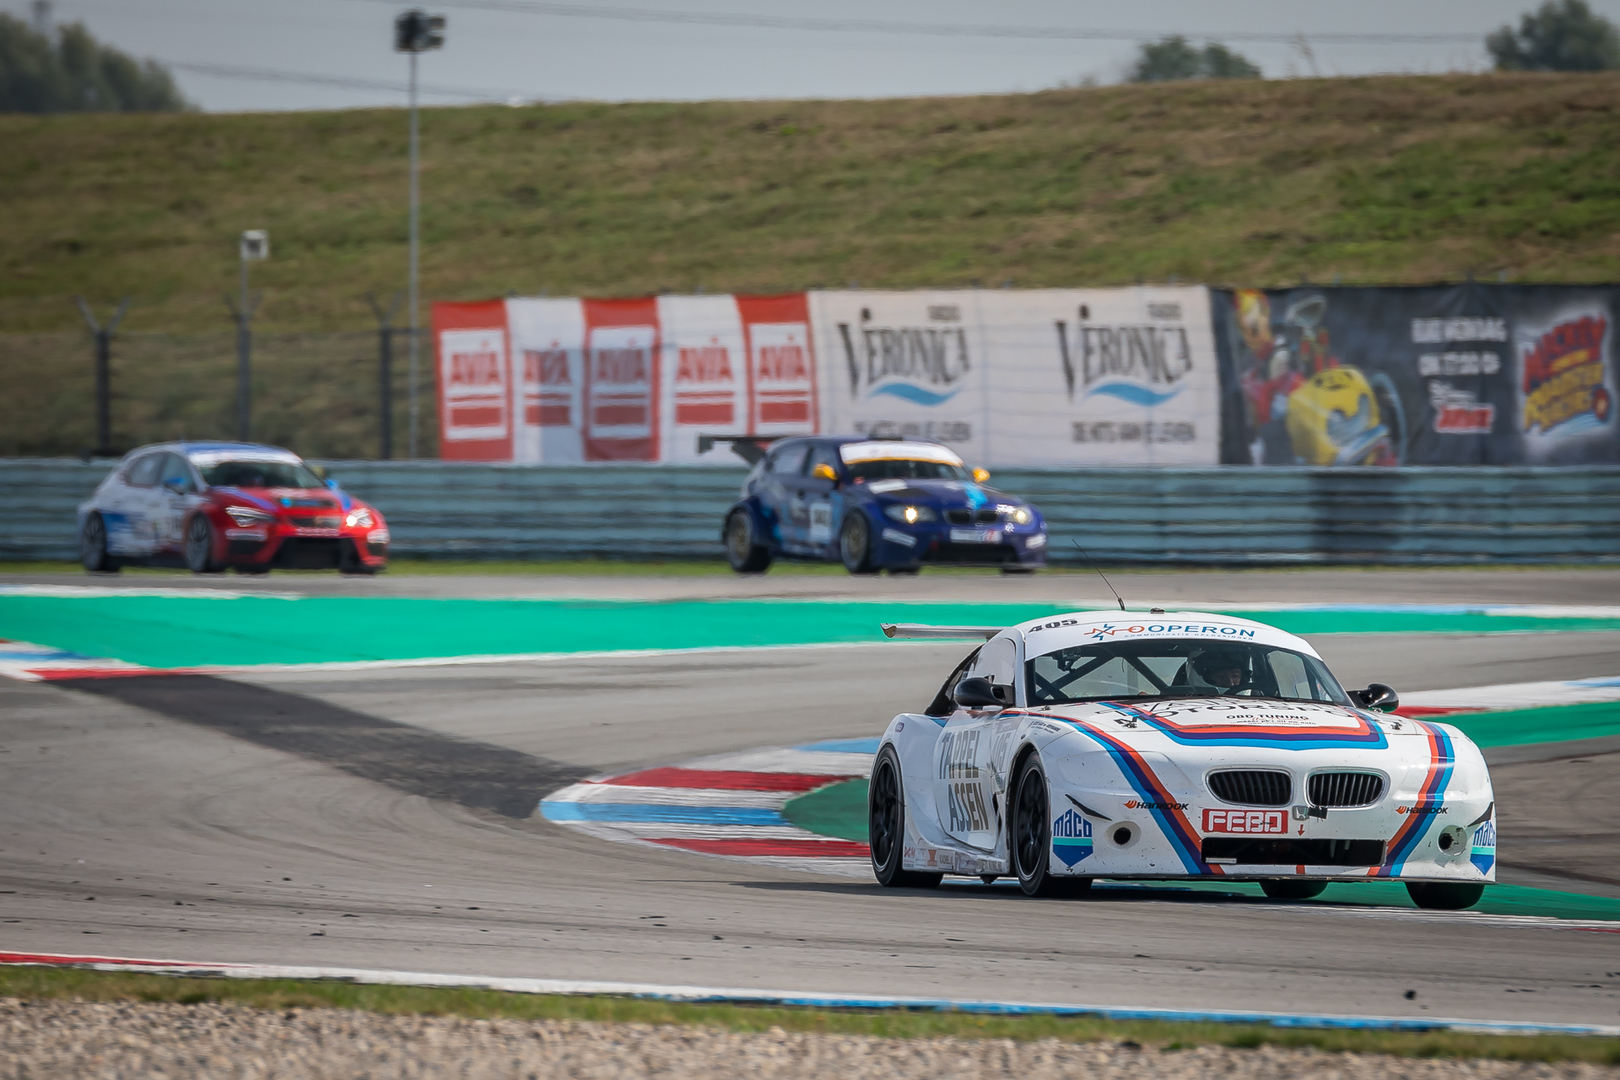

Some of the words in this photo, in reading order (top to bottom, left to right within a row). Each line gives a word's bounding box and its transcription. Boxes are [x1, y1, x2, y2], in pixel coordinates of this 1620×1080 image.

[836, 307, 971, 402] VERONICA
[1055, 304, 1194, 403] VERONICA
[1028, 618, 1078, 633] 405
[939, 730, 980, 779] TAPPEL
[948, 782, 989, 832] ASSEN
[1208, 810, 1283, 833] FEBO
